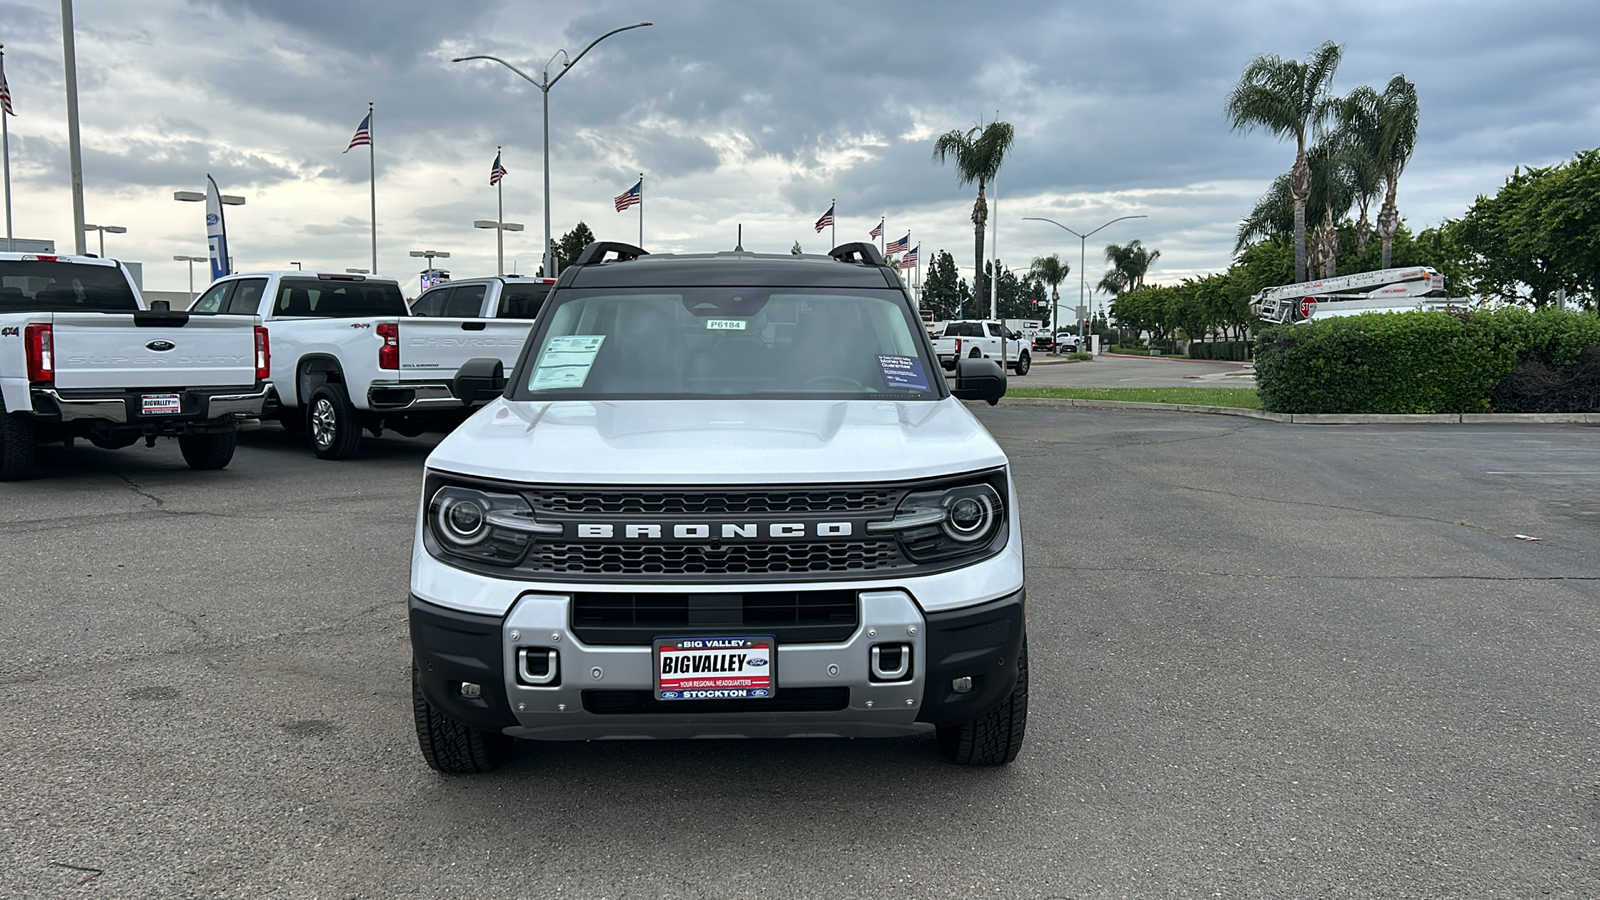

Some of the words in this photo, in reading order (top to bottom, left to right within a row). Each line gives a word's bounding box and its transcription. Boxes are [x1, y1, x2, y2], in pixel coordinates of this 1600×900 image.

[710, 321, 741, 329] P6184
[67, 355, 169, 365] SUPER
[176, 354, 246, 364] DUTY
[577, 522, 852, 539] BRONCO
[683, 640, 703, 648] BIG
[705, 639, 745, 647] VALLEY
[715, 679, 752, 687] HEADQUARTERS
[682, 689, 747, 699] STOCKTON
